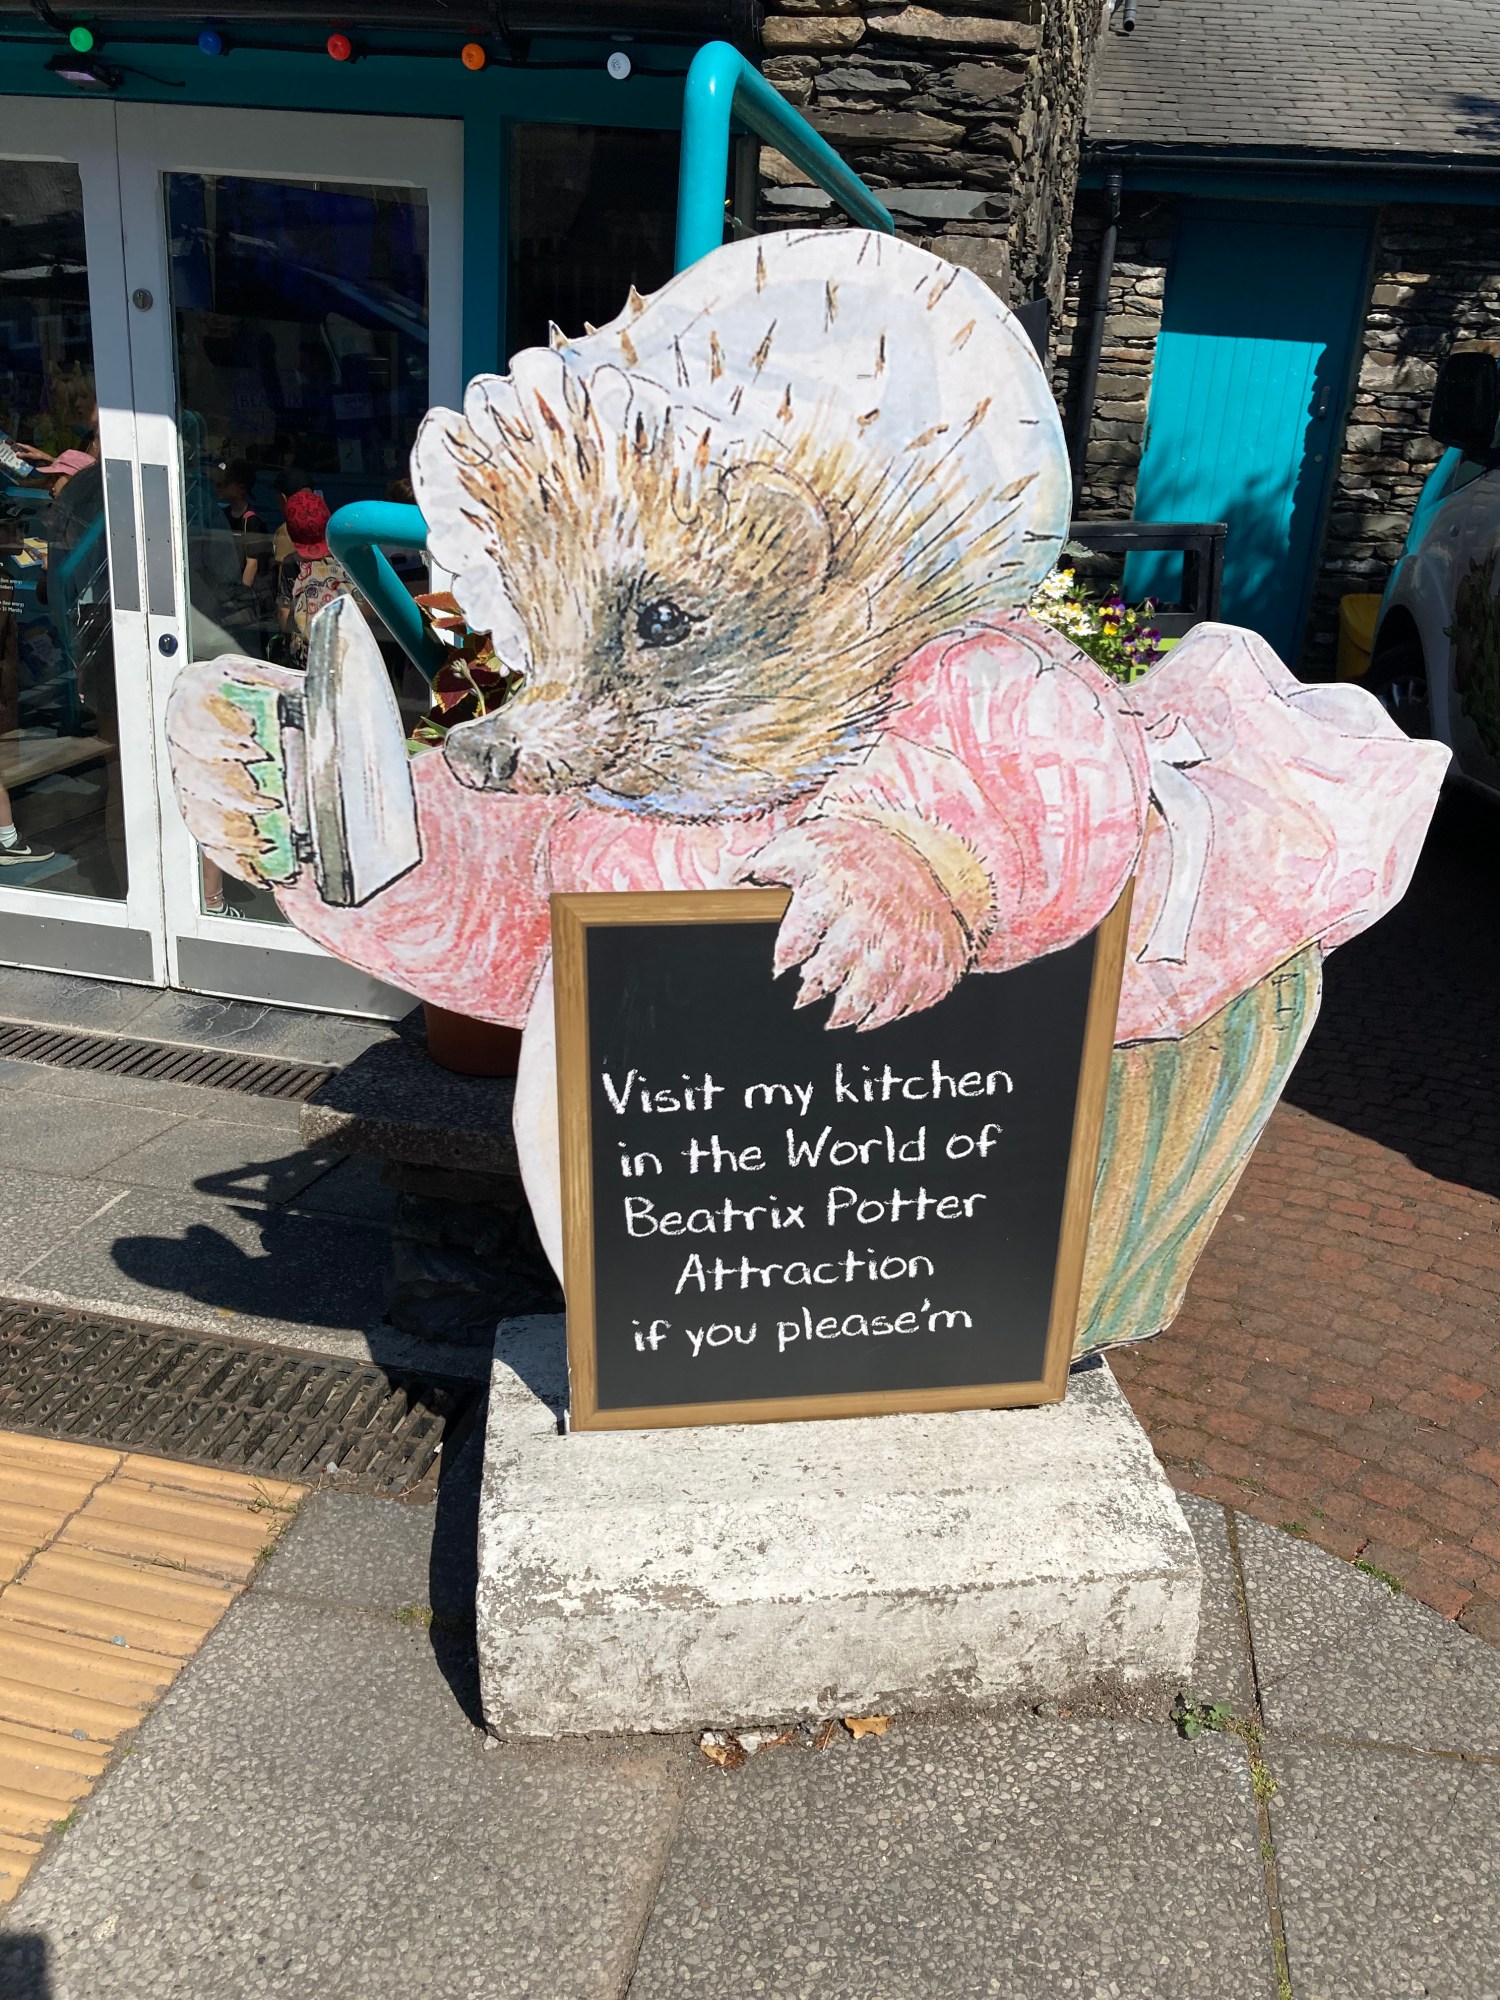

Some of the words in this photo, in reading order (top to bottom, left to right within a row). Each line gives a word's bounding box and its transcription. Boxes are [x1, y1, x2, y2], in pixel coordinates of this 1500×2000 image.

[602, 1069, 726, 1115] Visit
[745, 1082, 814, 1117] my
[835, 1060, 1014, 1103] kitchen
[618, 1141, 663, 1178] in
[681, 1135, 767, 1175] the
[786, 1126, 926, 1168] World
[946, 1124, 1004, 1160] of
[624, 1195, 806, 1238] Beatrix
[827, 1186, 987, 1227] Potter
[675, 1248, 935, 1295] Attraction
[631, 1320, 672, 1352] if
[686, 1323, 758, 1358] you
[777, 1298, 973, 1353] please'm
